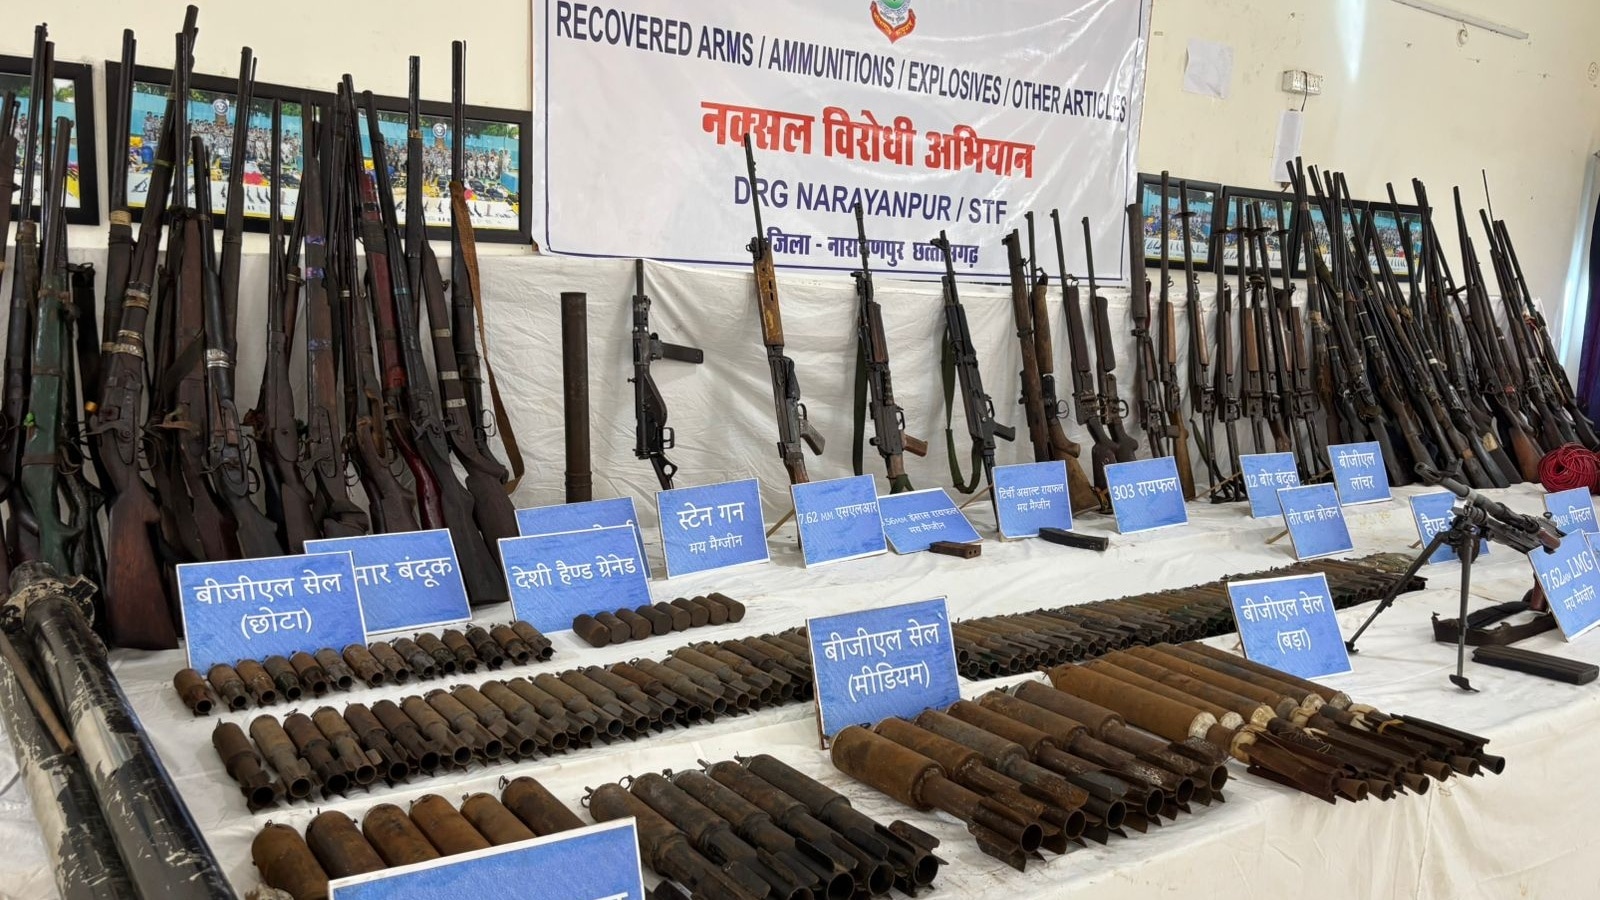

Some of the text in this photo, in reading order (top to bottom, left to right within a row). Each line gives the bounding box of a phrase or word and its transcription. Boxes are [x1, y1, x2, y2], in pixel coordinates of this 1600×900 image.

[556, 1, 1127, 123] RECOVERED ARMS / AMMUNITIONS / EXPLOSIVES / OTHER ARTICLES
[700, 101, 1036, 178] नक्सल विरोधी अभियान
[734, 175, 1008, 225] DRG NARAYANPUR / STF
[766, 226, 812, 255] जिला
[1337, 450, 1376, 469] बीजीएल
[1041, 483, 1065, 495] रायफल
[1112, 477, 1178, 501] 303 रायफल
[1247, 468, 1296, 489] 12 बोर बंदूक
[1350, 473, 1375, 490] लांचर
[676, 502, 745, 531] स्टेन गन
[798, 511, 819, 525] 7.62
[835, 501, 878, 520] एसएलआर
[930, 507, 960, 518] रायफल
[1016, 502, 1028, 513] मय
[1287, 508, 1304, 525] तीर
[1302, 509, 1317, 523] बम
[1568, 505, 1592, 524] पिस्टल
[1420, 512, 1449, 539] हैण्ड
[688, 532, 743, 555] मय मैग्जीन
[394, 556, 452, 588] बंदूक
[511, 554, 636, 589] देशी हैण्ड ग्रेनेड
[1566, 551, 1593, 578] LMG
[193, 569, 343, 605] बीजीएल सेल
[1241, 591, 1325, 622] बीजीएल सेल
[1563, 596, 1577, 611] मय
[240, 606, 314, 640] (छोटा)
[822, 618, 940, 662] बीजीएल सेल
[1277, 627, 1312, 655] (बड़ा)
[848, 659, 930, 703] (मीडियम)
